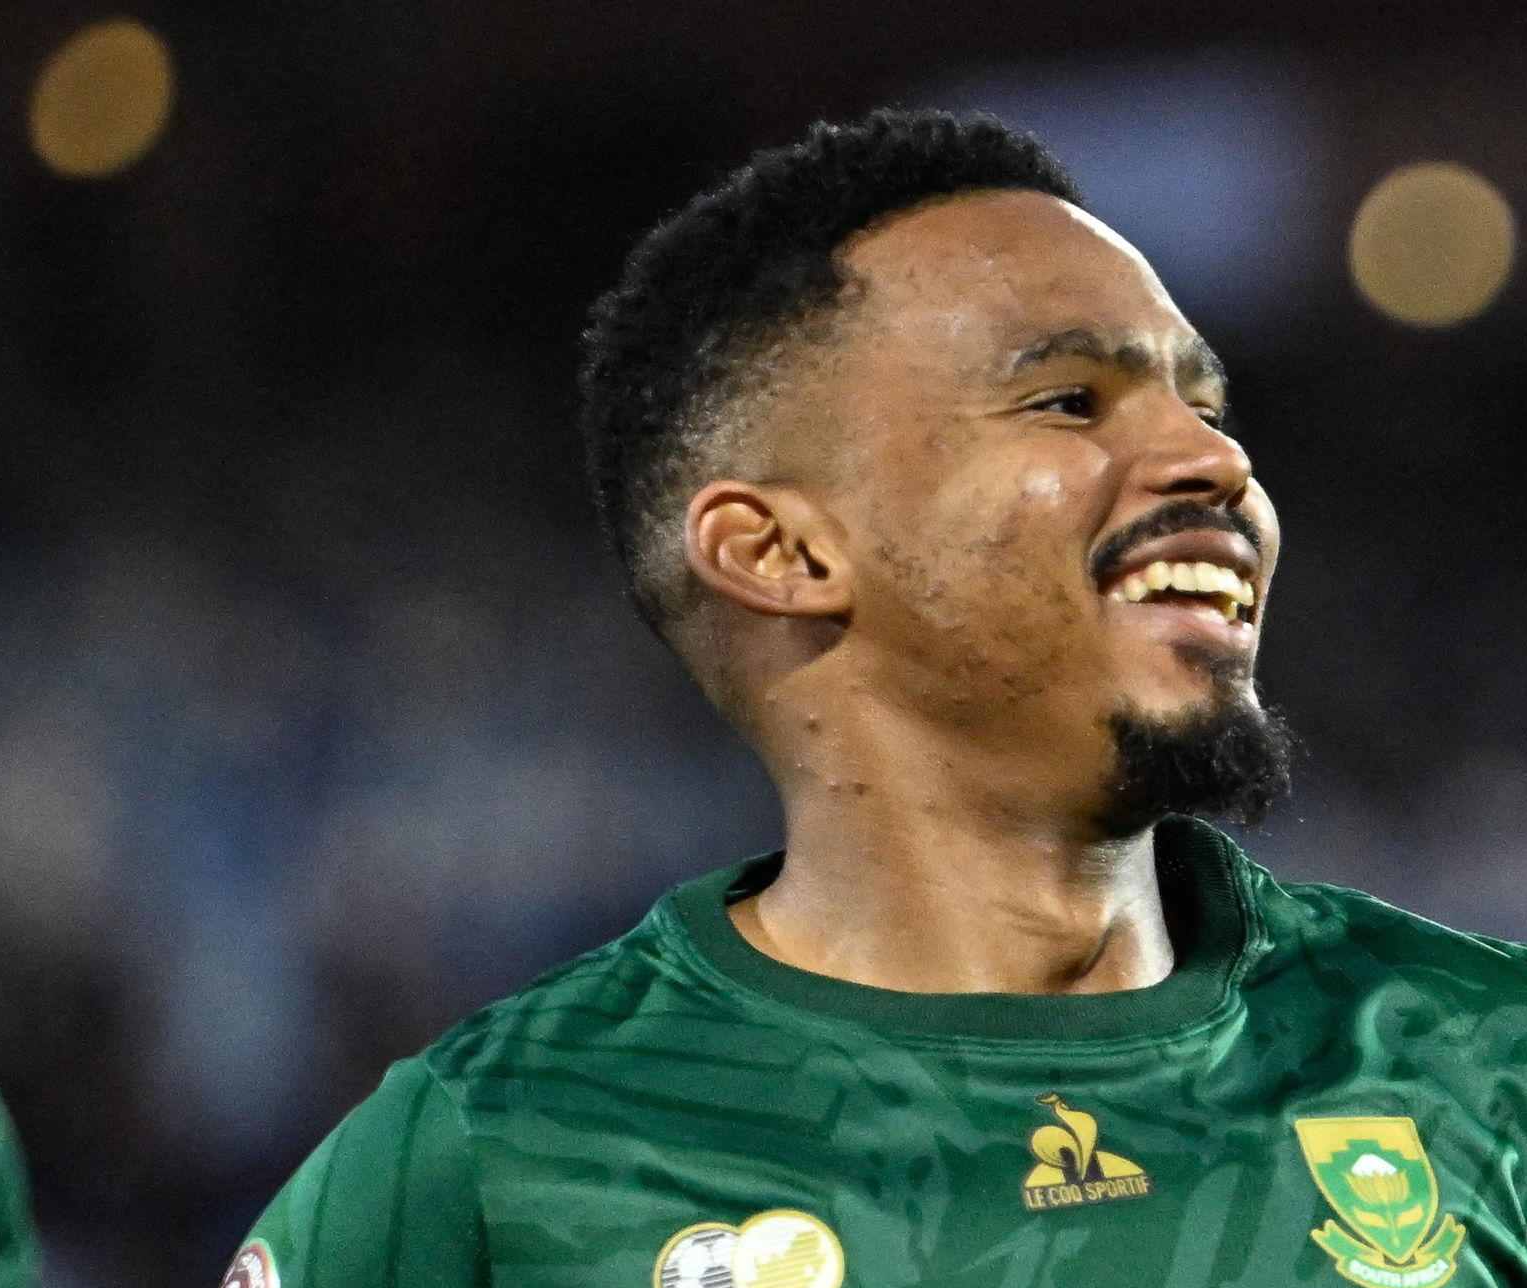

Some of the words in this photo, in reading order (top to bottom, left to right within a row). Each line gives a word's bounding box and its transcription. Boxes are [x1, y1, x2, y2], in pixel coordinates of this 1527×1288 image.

[1026, 1188, 1045, 1209] LE
[1048, 1183, 1083, 1206] COQ
[1085, 1176, 1150, 1200] SPORTIF
[1349, 1258, 1401, 1288] SOUTH
[1402, 1258, 1449, 1288] AFRICA
